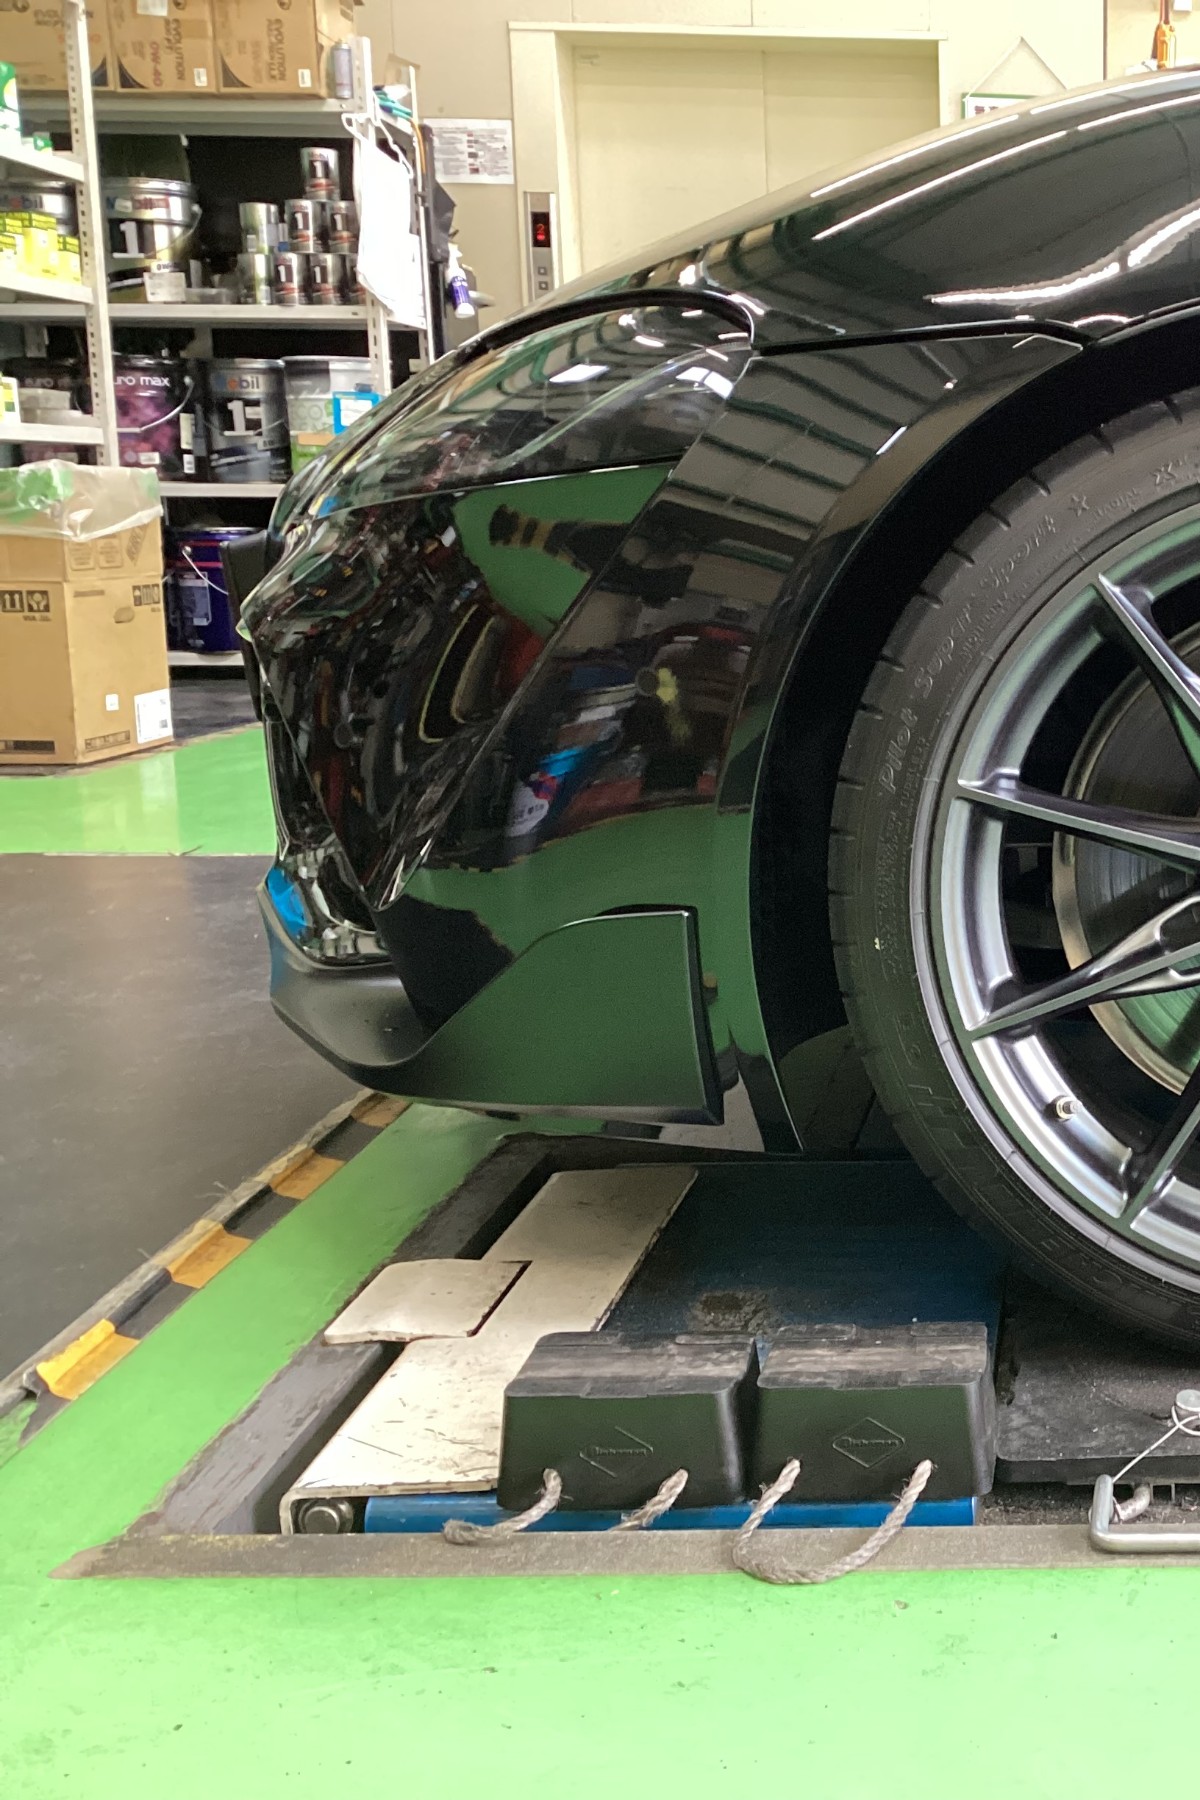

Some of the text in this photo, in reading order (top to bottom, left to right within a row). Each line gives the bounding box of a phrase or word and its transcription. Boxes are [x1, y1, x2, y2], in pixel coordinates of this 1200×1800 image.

[112, 221, 145, 258] 1
[140, 376, 170, 387] max
[224, 400, 255, 436] 1
